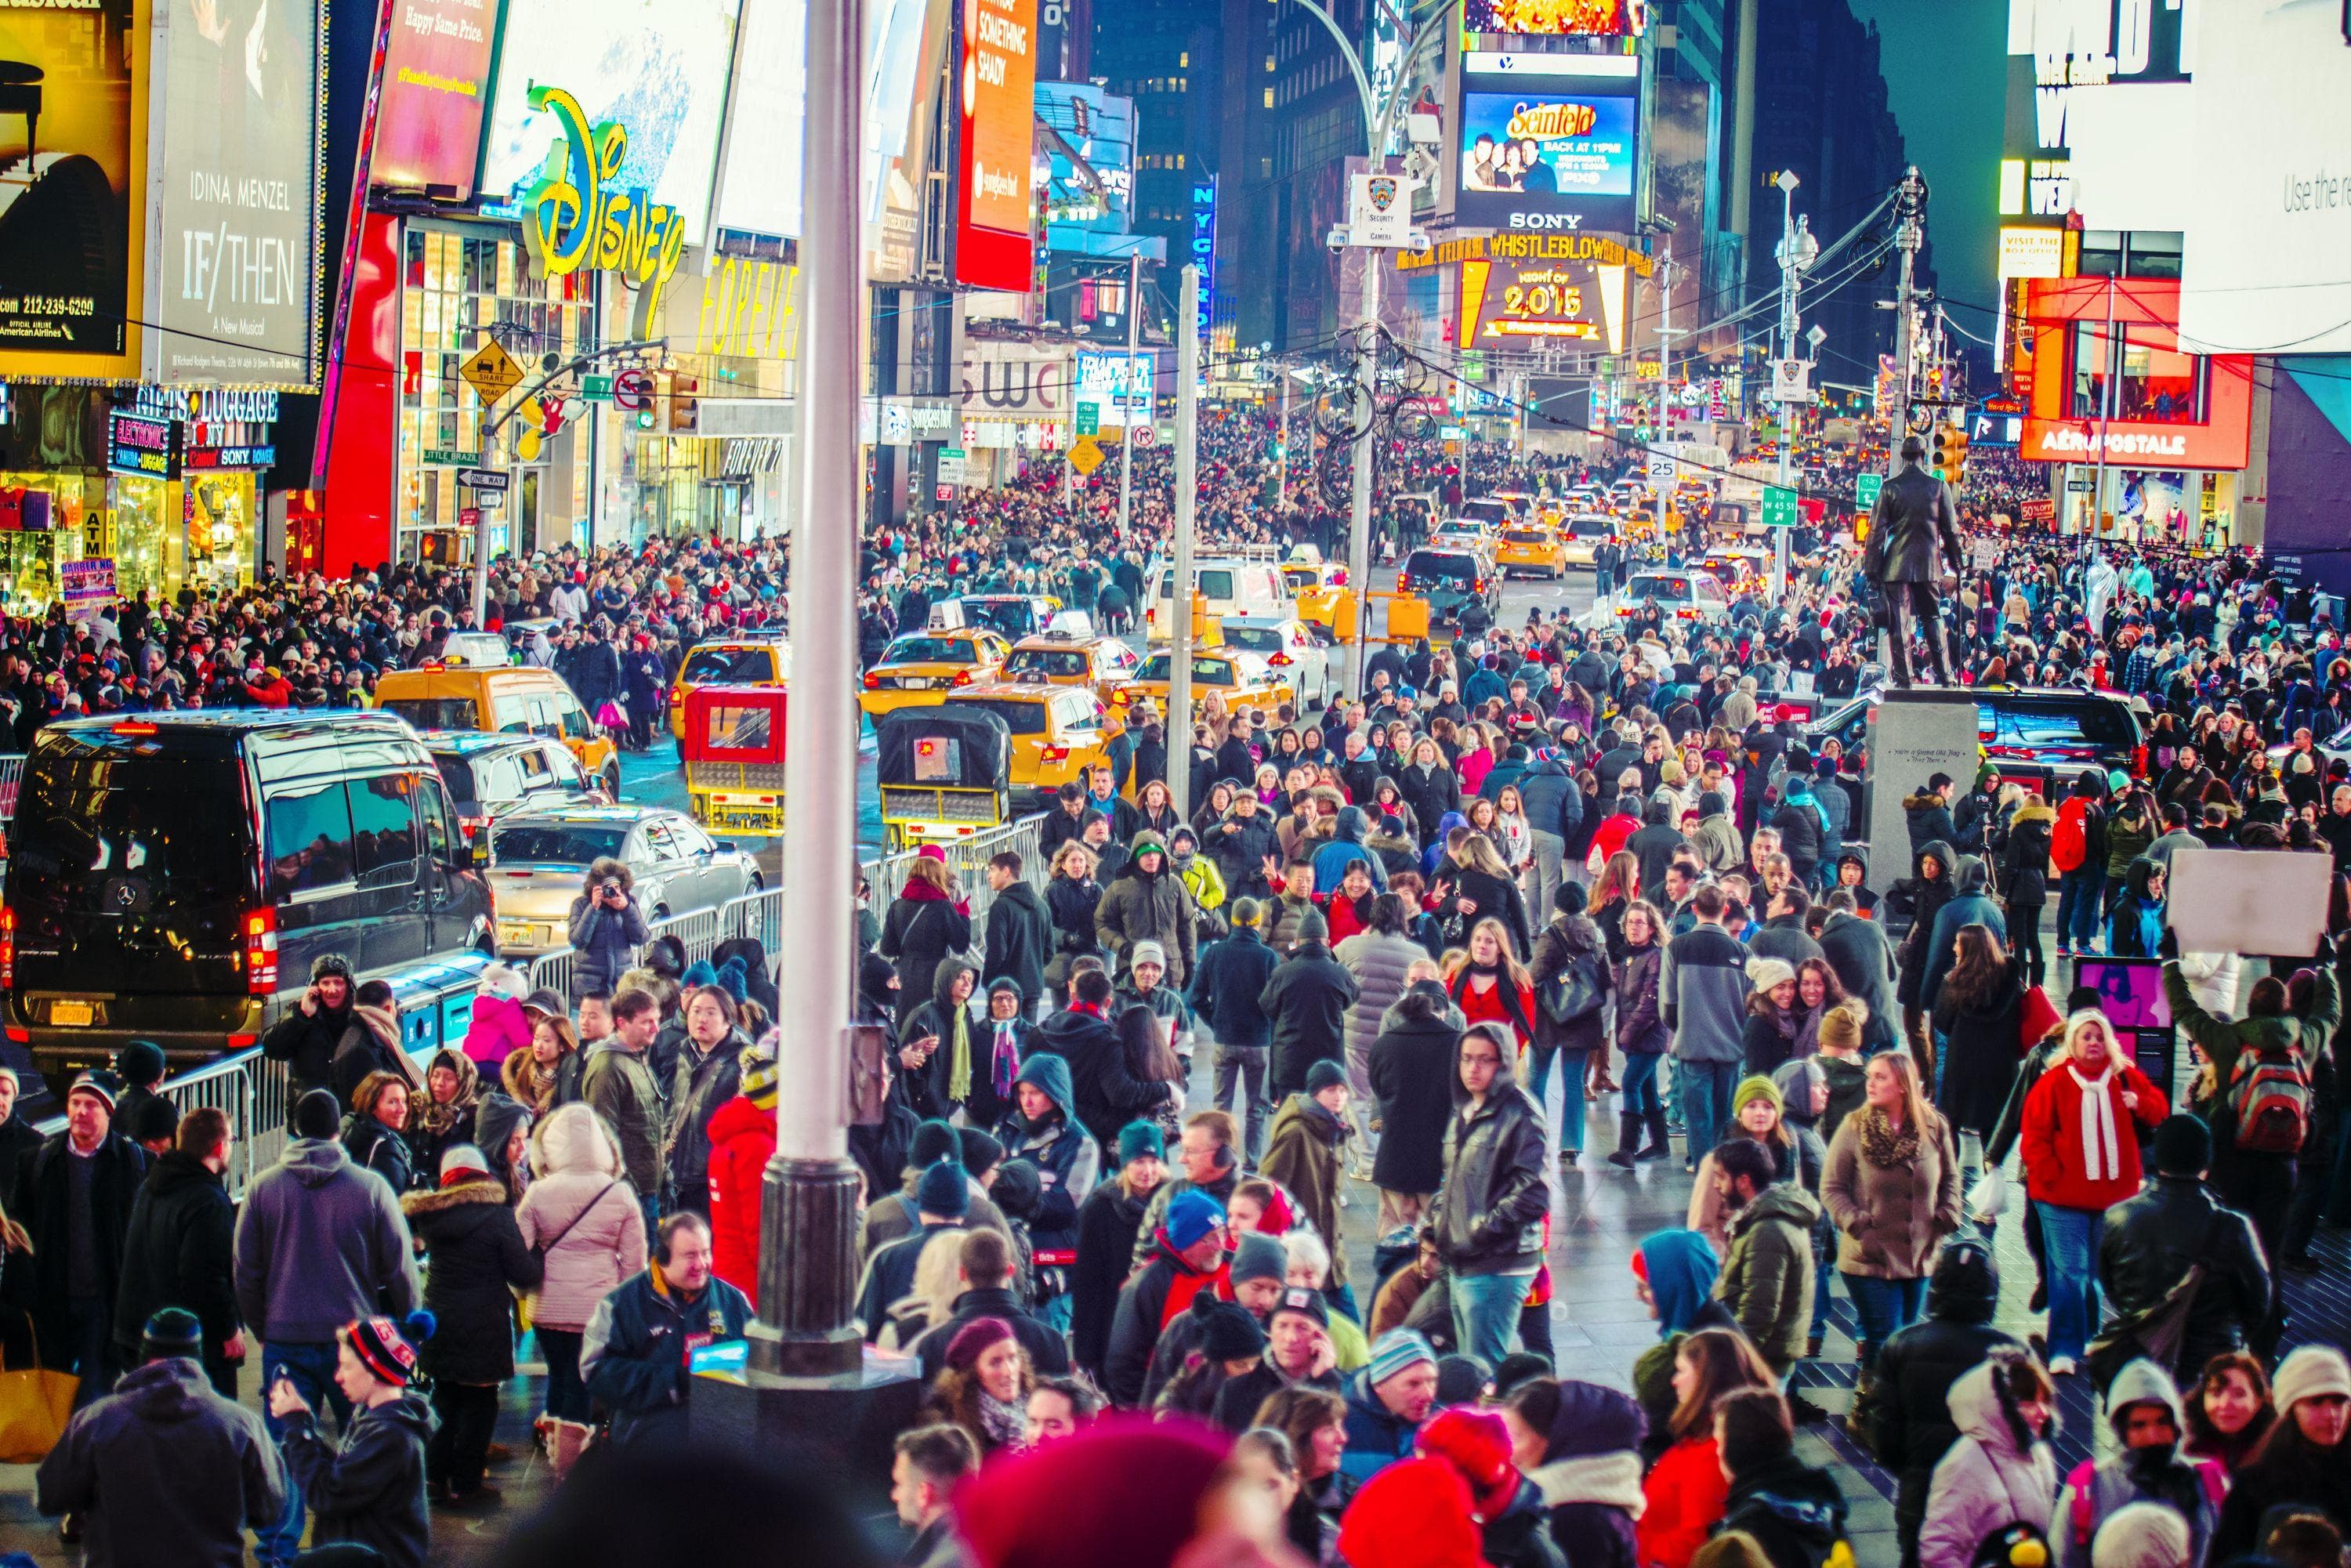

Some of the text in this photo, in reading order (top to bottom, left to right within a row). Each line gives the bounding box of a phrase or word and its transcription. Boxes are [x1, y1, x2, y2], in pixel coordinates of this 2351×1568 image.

[404, 5, 434, 36] Happy
[434, 13, 458, 38] Same
[979, 10, 1027, 56] SOMETHING
[978, 50, 1006, 87] SHADY
[1511, 102, 1596, 136] Seinfeld
[1544, 142, 1574, 153] BACK
[1576, 142, 1589, 153] AT
[190, 170, 290, 212] IDINA MENZEL
[984, 168, 1008, 201] sunglass
[1008, 171, 1018, 197] hut
[2284, 174, 2310, 212] Use
[2315, 168, 2337, 209] the
[1509, 213, 1582, 230] SONY
[182, 222, 295, 313] IF/THEN
[23, 295, 94, 316] 212-239-6200
[32, 320, 52, 329] AIRLINE
[212, 316, 265, 336] A New Musical
[479, 373, 505, 382] SHARE
[600, 380, 606, 393] 7
[201, 389, 278, 423] LUGGAGE
[940, 400, 952, 429] hut
[206, 423, 225, 445] NY
[2041, 428, 2186, 455] AÉROPOSTALE
[189, 450, 218, 467] Canon
[221, 450, 250, 465] SONY
[424, 450, 478, 462] LITTLE BRAZIL
[470, 474, 503, 485] ONE WAY
[1651, 462, 1672, 476] 25
[85, 512, 100, 555] ATM
[62, 559, 112, 573] BARBERNG
[1038, 1253, 1056, 1262] tkts
